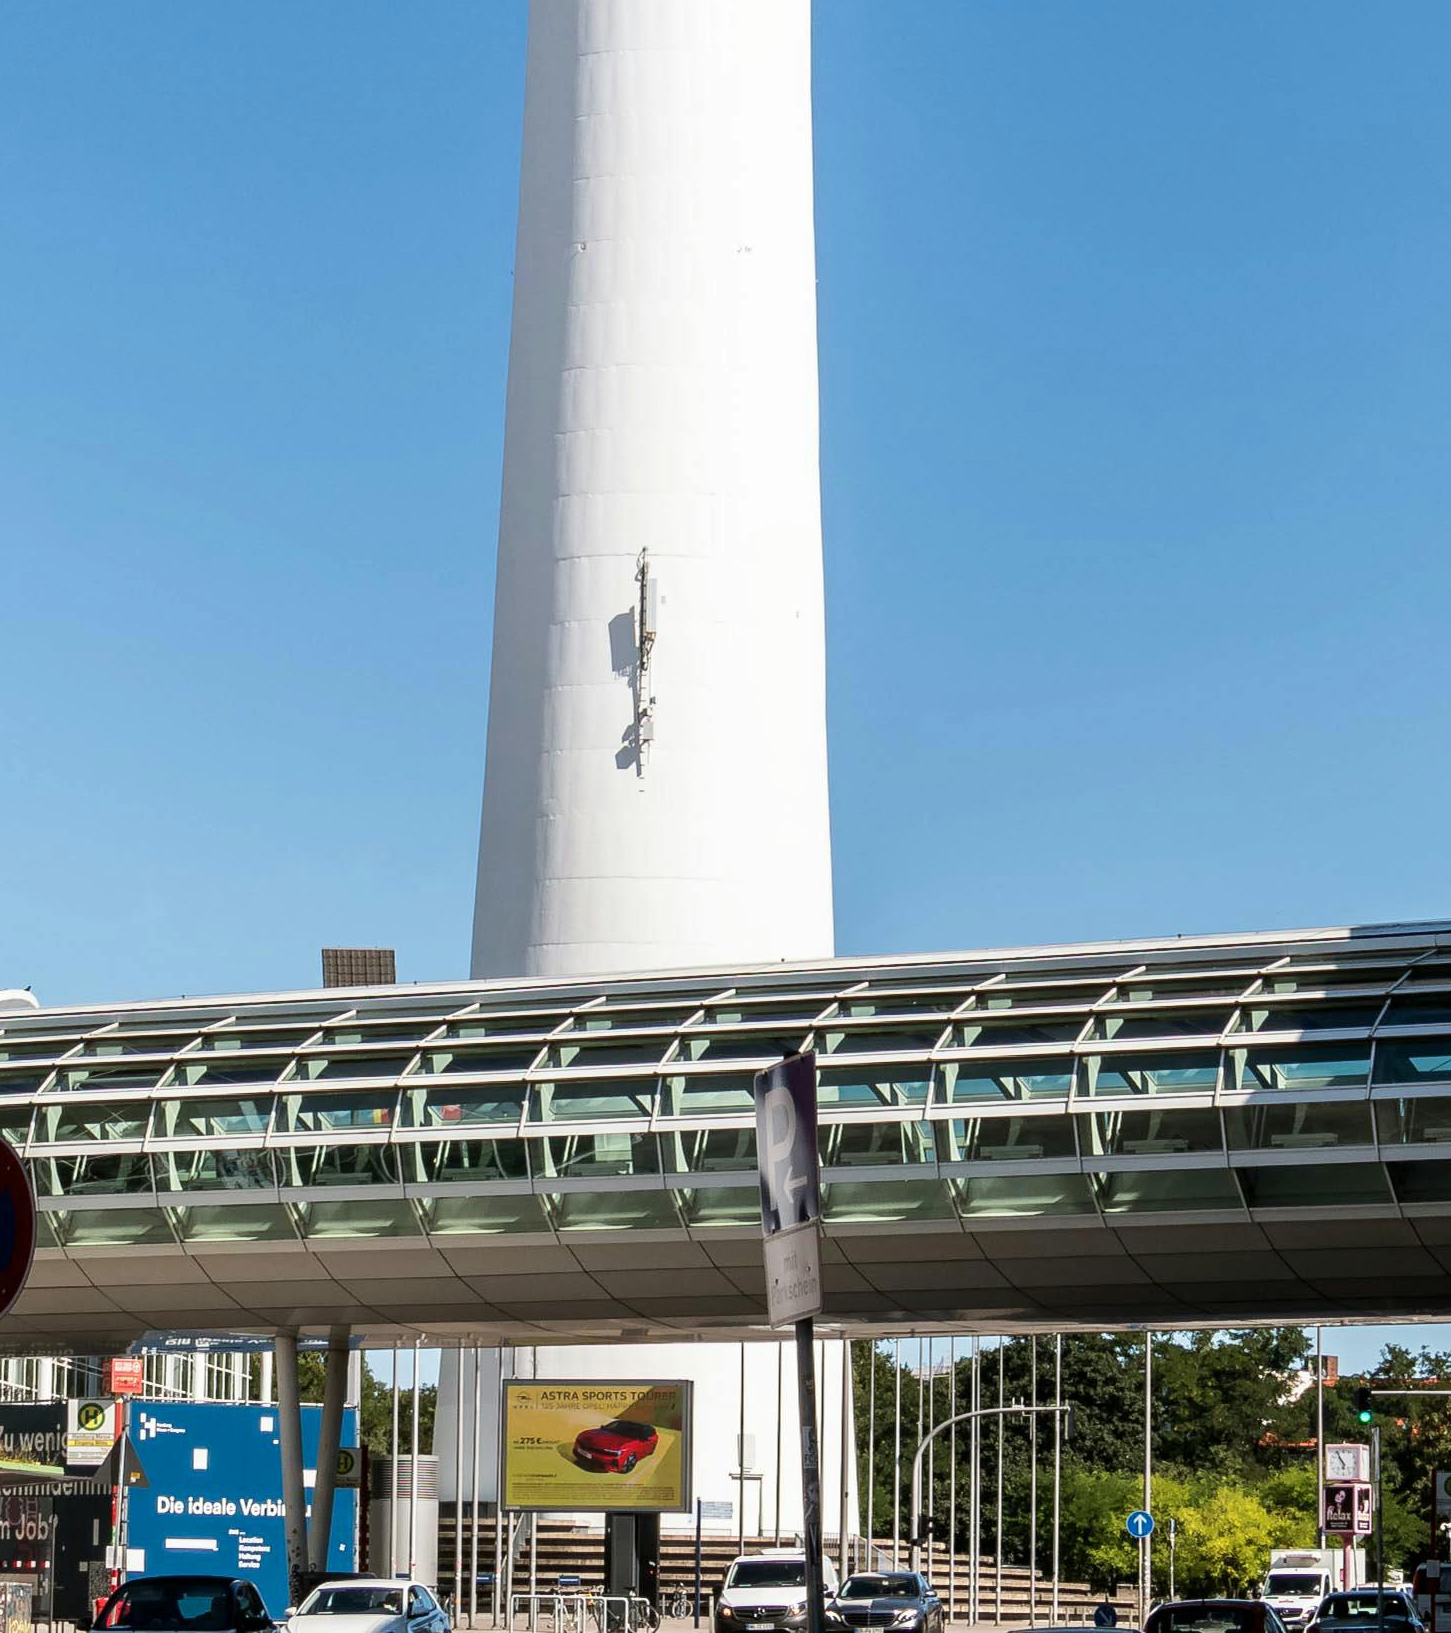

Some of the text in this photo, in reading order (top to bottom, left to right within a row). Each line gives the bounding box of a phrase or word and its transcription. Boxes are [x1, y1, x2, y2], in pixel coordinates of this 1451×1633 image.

[765, 1086, 797, 1212] P
[541, 1391, 677, 1401] ASTRA SPORTS TOURER
[19, 1423, 68, 1458] wenig
[520, 1437, 535, 1445] 275
[157, 1496, 312, 1517] Die ideale Verbi
